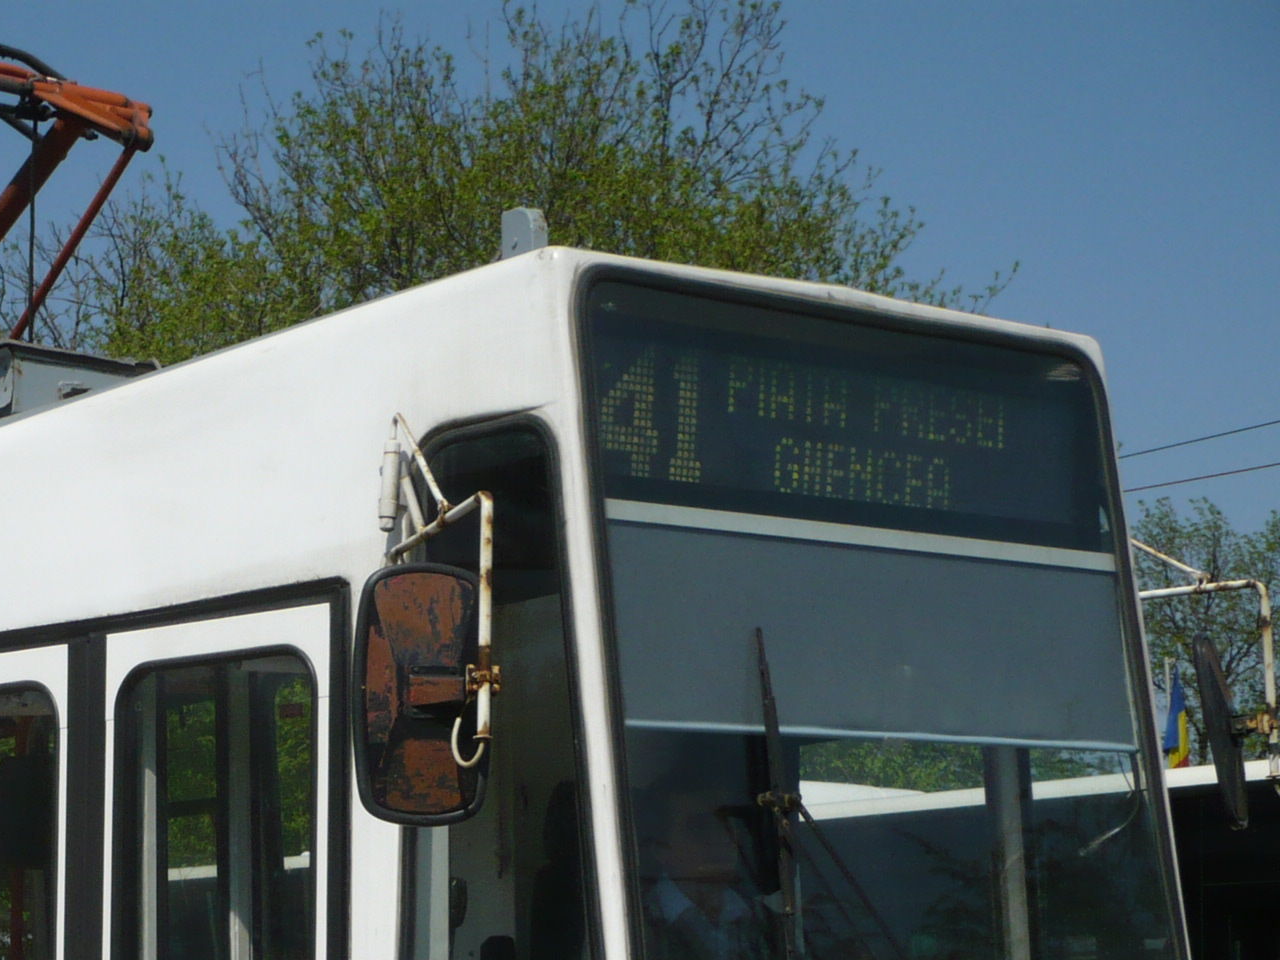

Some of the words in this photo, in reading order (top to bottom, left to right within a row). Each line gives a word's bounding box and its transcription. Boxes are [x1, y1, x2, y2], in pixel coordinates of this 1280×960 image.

[599, 345, 703, 483] 41
[727, 357, 847, 429] PIATA
[774, 436, 951, 511] GHENCEA
